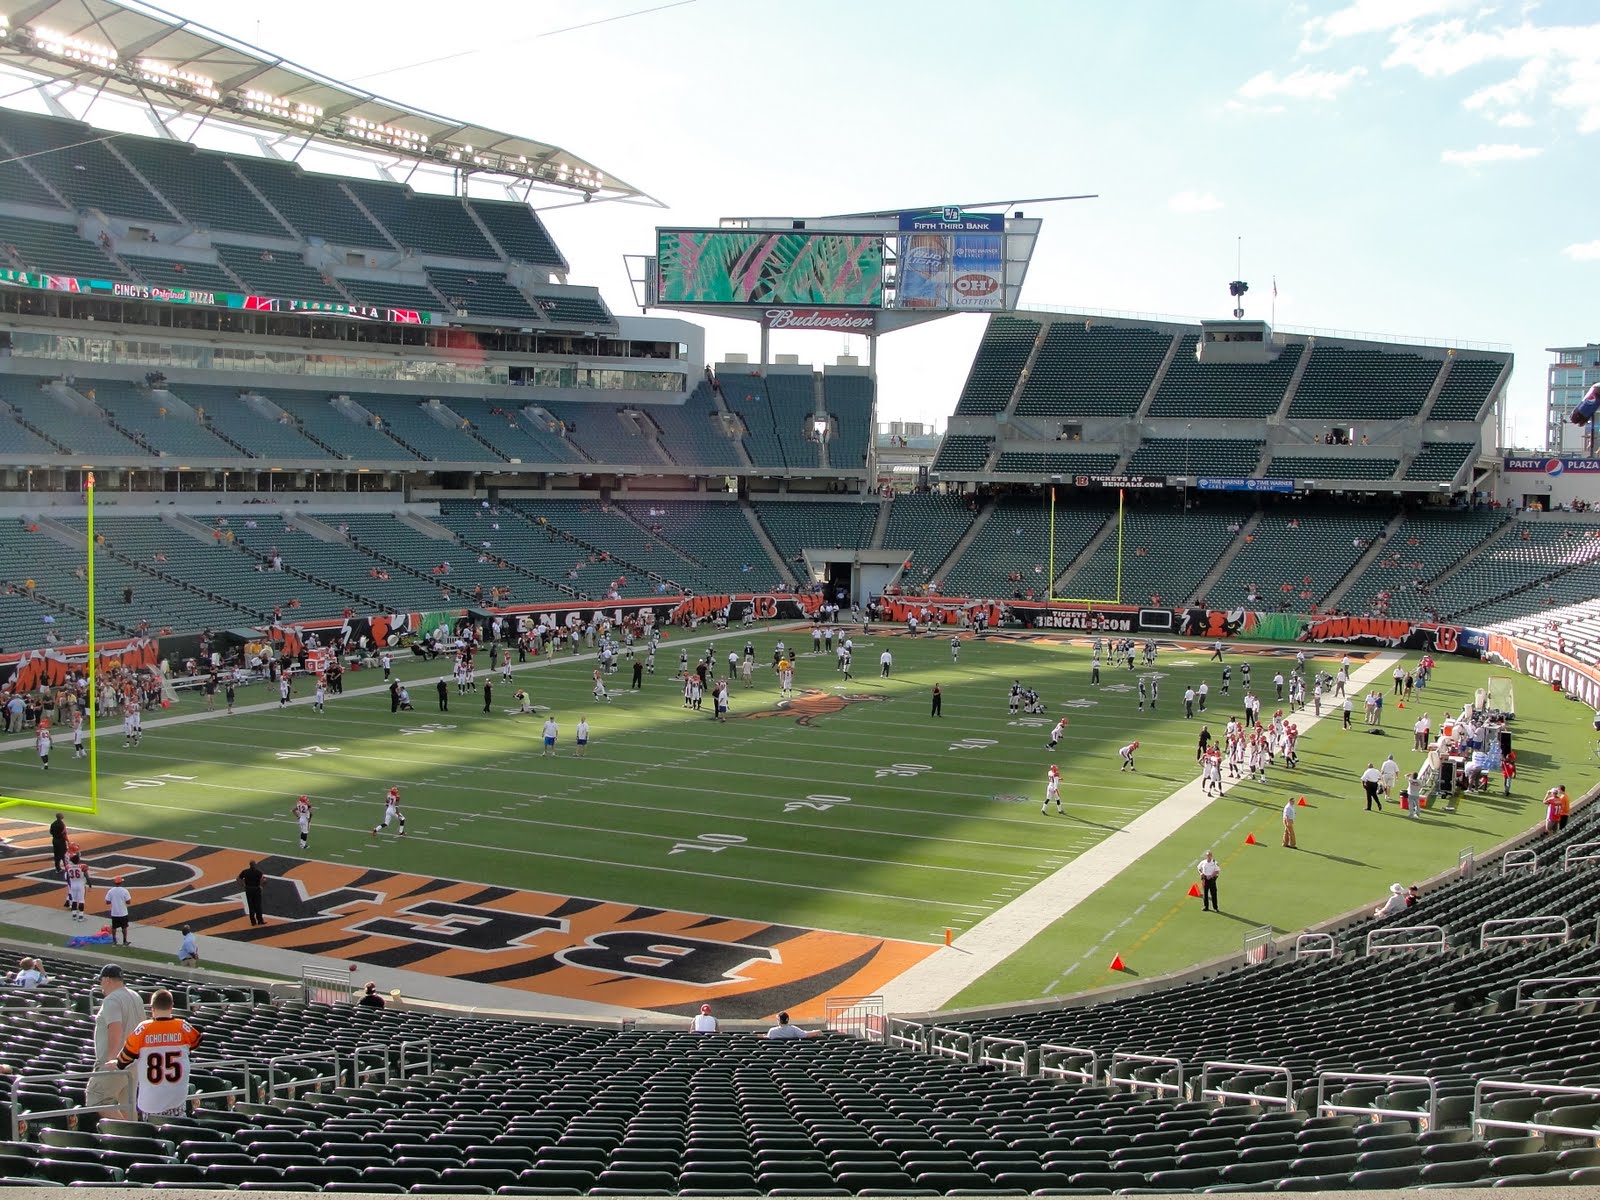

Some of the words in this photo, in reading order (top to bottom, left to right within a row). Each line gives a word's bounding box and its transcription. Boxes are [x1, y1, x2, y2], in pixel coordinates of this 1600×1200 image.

[914, 222, 937, 230] FIFTH
[940, 222, 964, 230] THIRD
[966, 222, 990, 230] BANK
[913, 251, 942, 260] BUD
[907, 258, 942, 268] LIGHT
[0, 270, 29, 284] IA
[956, 278, 994, 291] OH!
[114, 283, 149, 298] CINCY'S
[151, 287, 186, 301] Original
[189, 292, 215, 305] PIZZA
[765, 309, 873, 328] Budweiser
[1568, 461, 1599, 469] PLAZA
[875, 763, 933, 777] 30
[784, 794, 851, 811] 20
[672, 833, 748, 853] 10
[69, 869, 81, 879] 36
[145, 1034, 163, 1044] OCHO
[163, 1032, 182, 1043] CINCO
[146, 1050, 184, 1085] 85
